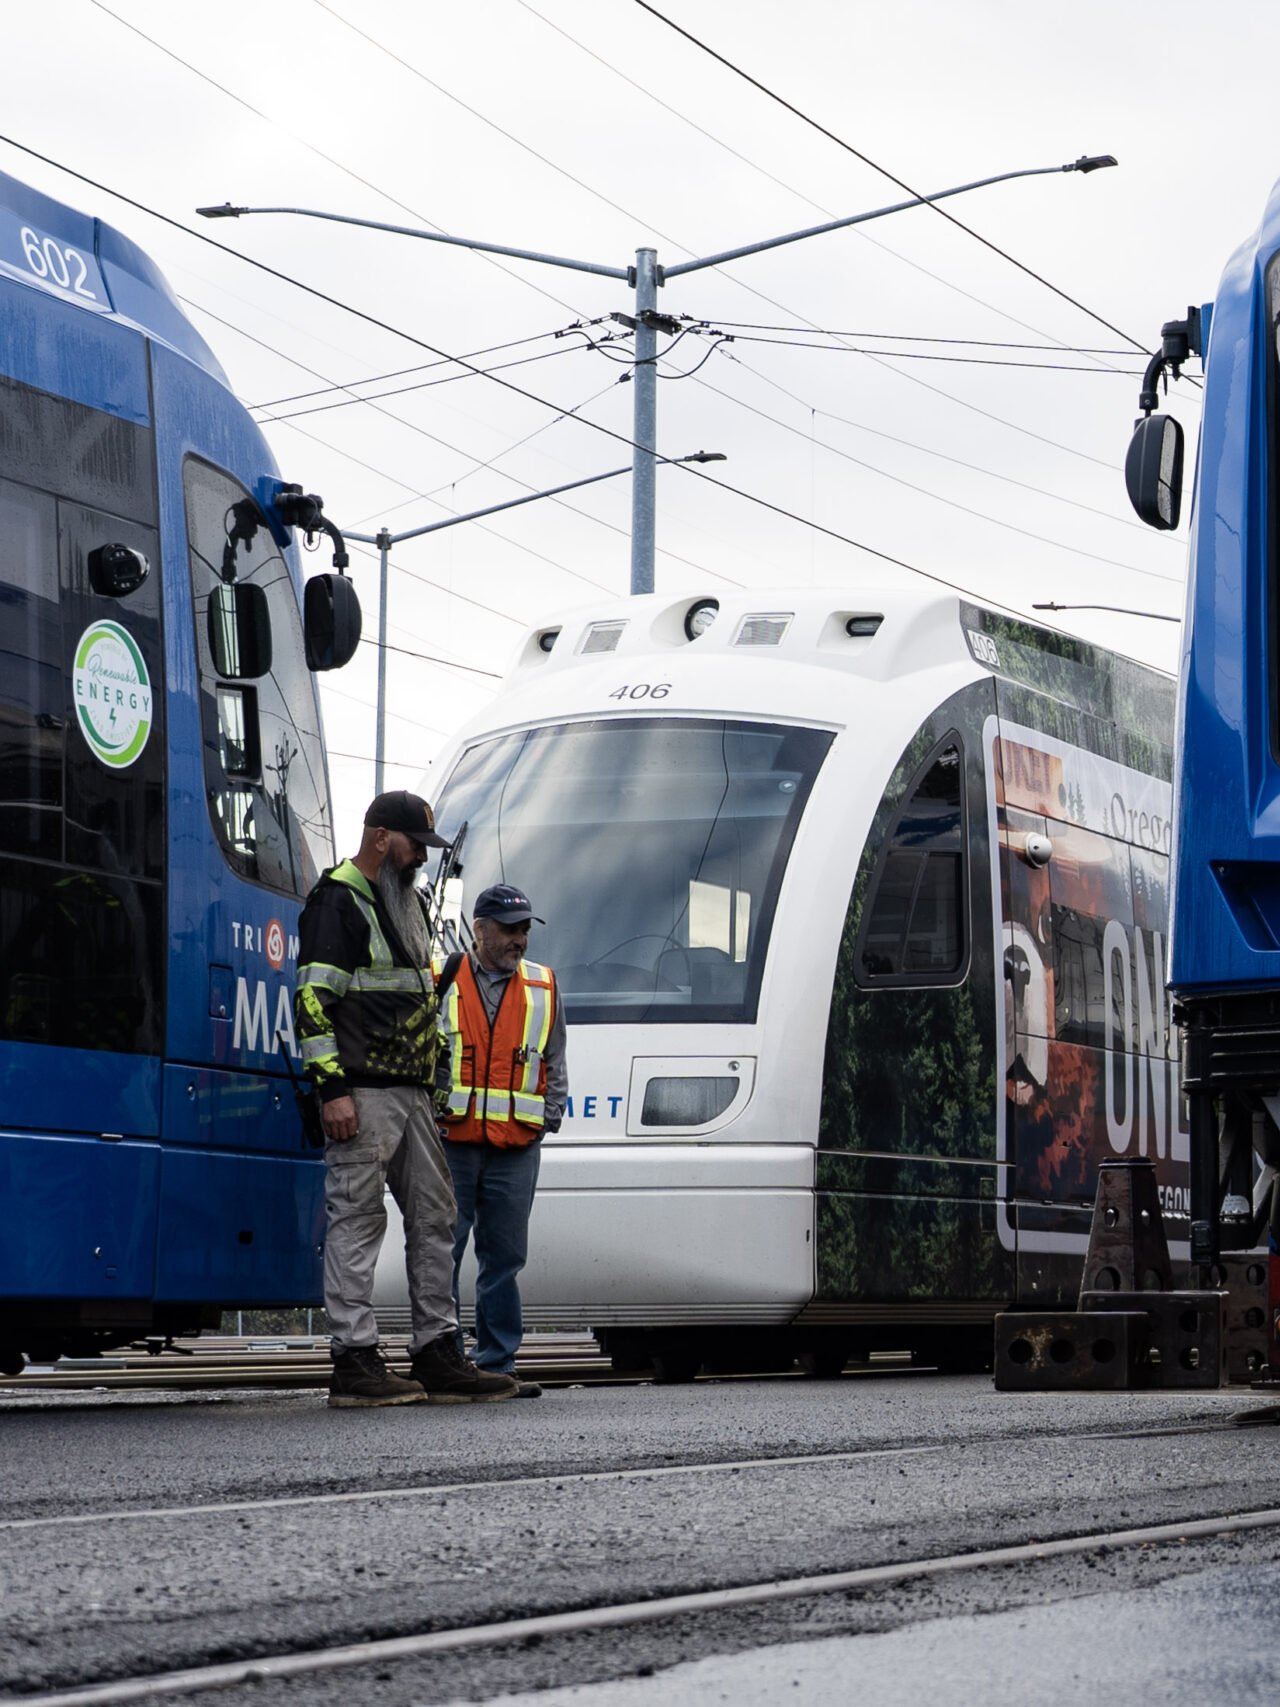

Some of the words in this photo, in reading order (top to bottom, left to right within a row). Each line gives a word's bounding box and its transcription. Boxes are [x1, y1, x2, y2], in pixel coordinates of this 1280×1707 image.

[20, 226, 97, 300] 602
[971, 632, 999, 665] 406
[87, 652, 138, 685] Renewable
[76, 678, 150, 718] ENERGY
[608, 683, 673, 700] 406
[232, 976, 303, 1059] MA
